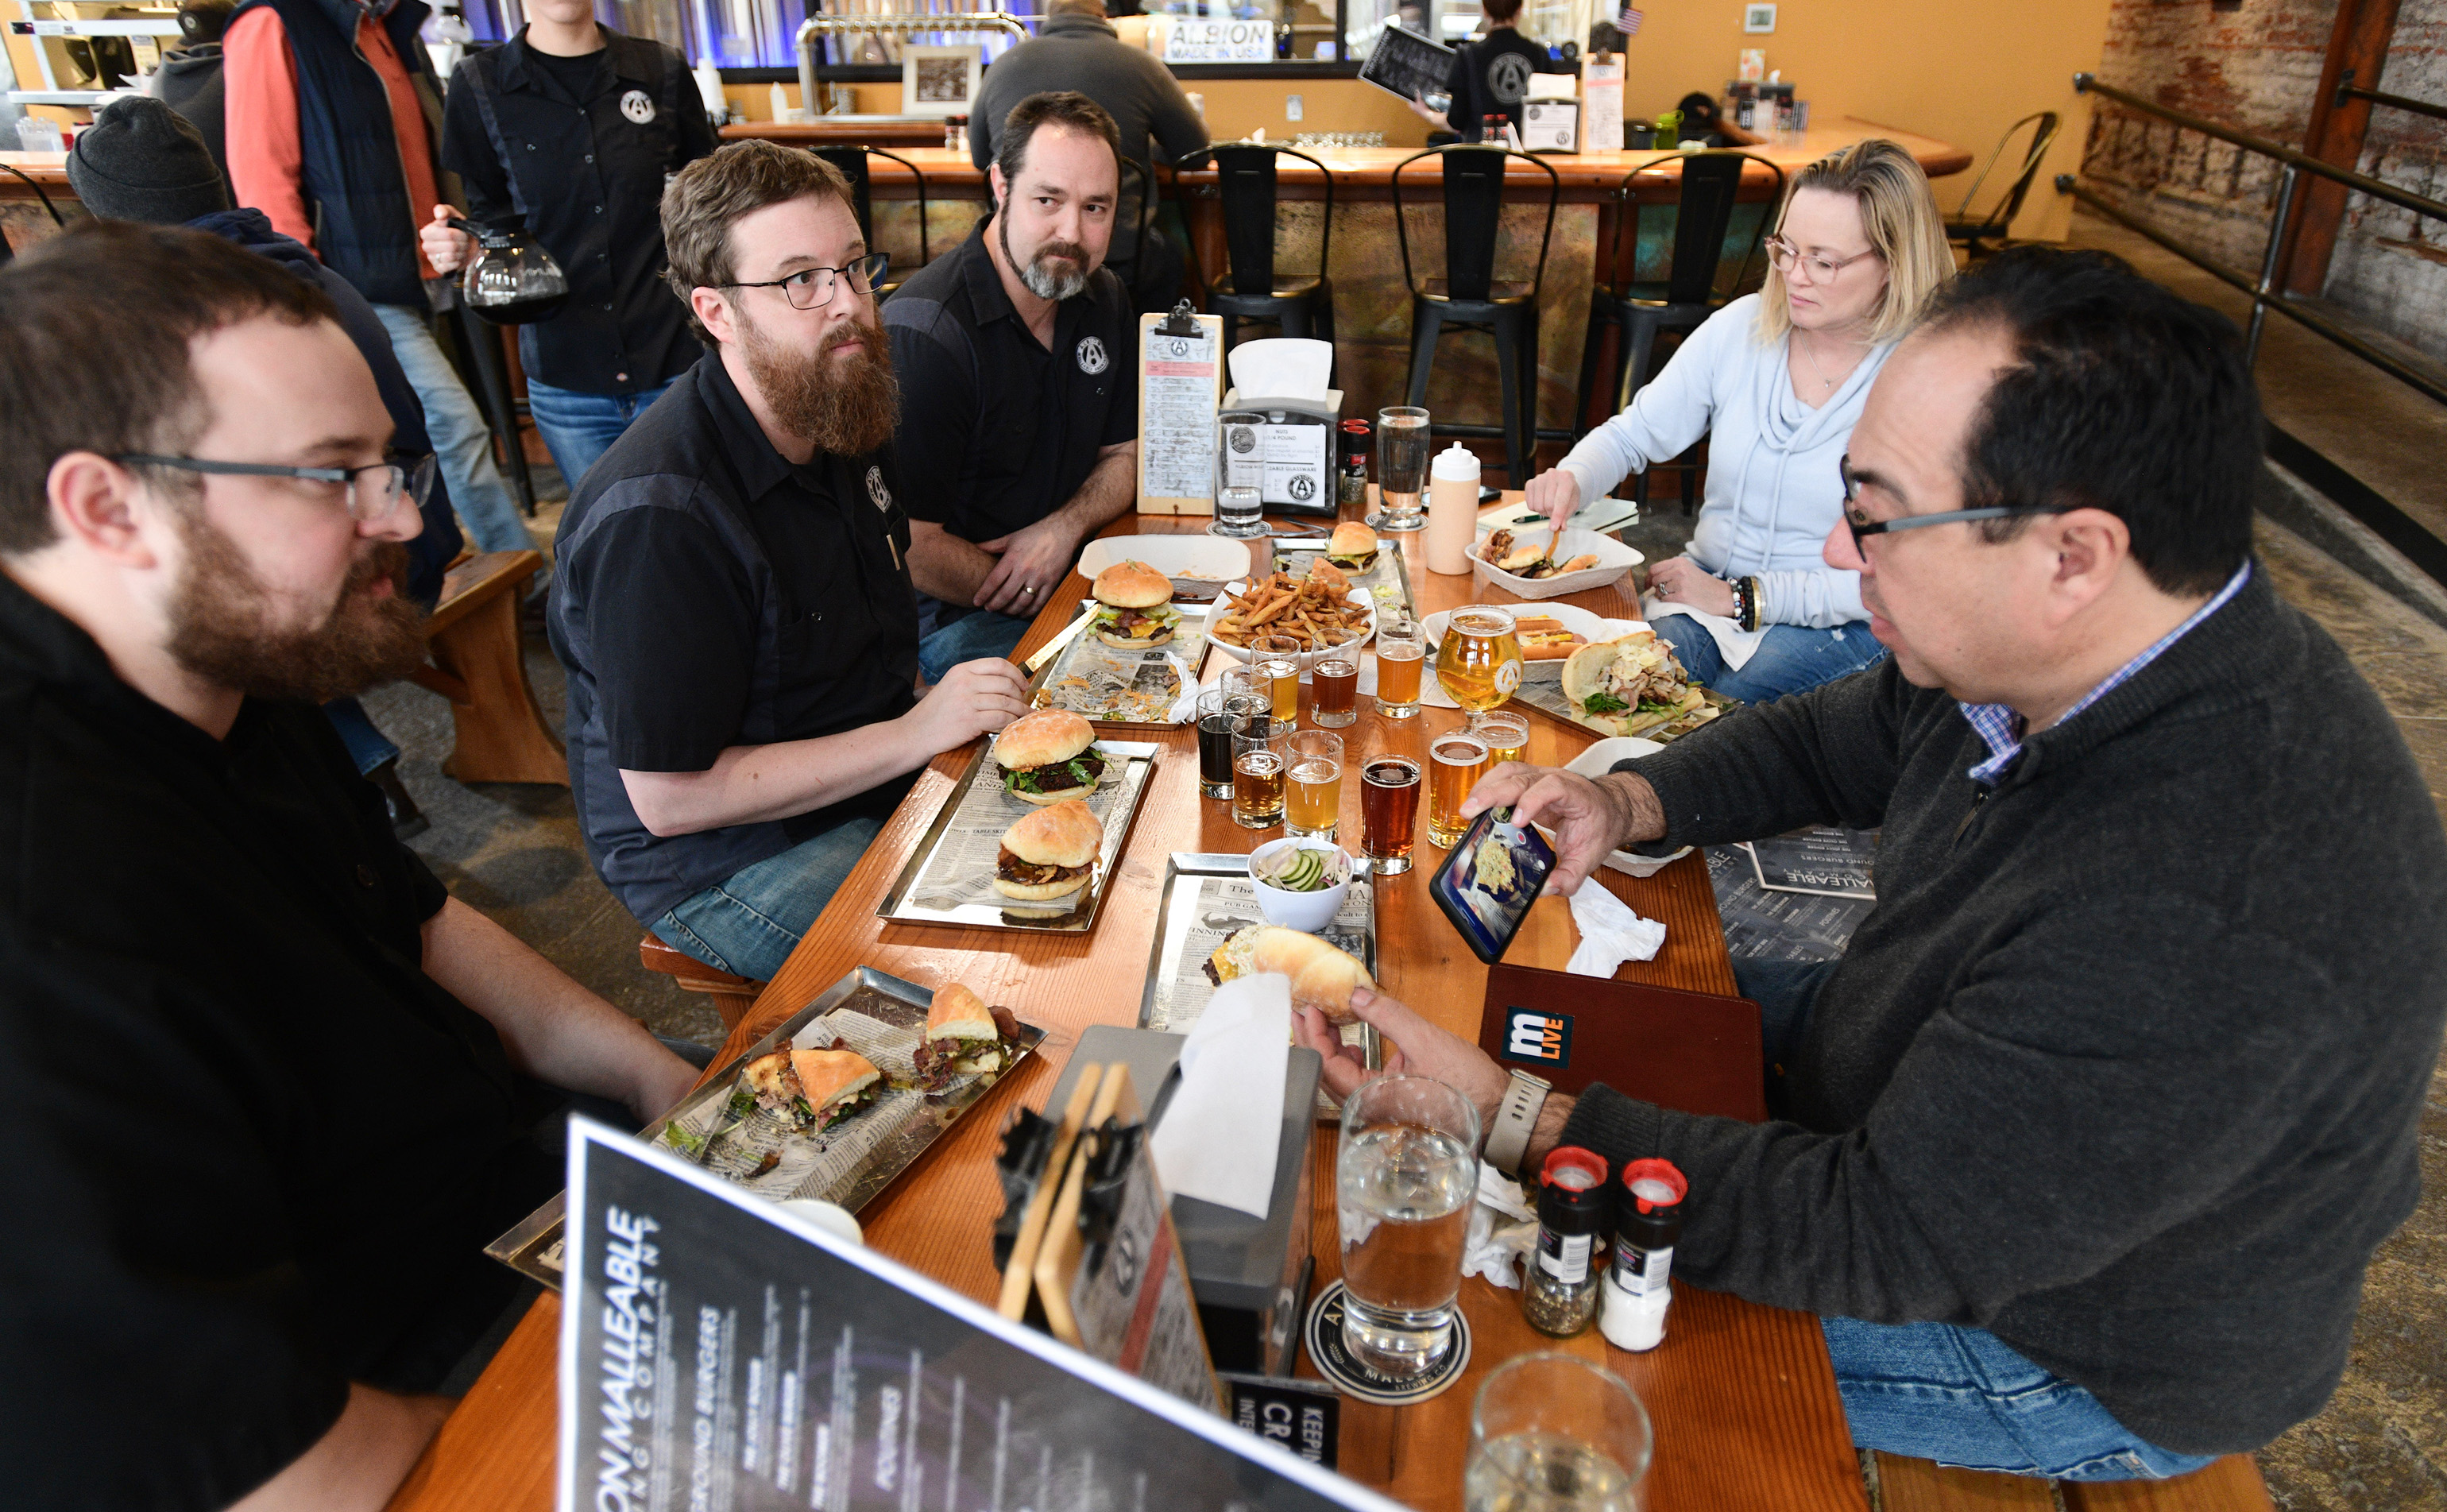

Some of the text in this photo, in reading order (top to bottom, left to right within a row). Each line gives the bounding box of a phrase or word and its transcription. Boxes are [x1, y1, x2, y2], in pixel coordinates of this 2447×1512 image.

[1170, 25, 1267, 44] ALBION
[1172, 46, 1266, 58] MADE IN USA
[1800, 854, 1844, 864] BURGERS
[1229, 884, 1254, 894] The
[1540, 1018, 1564, 1061] LIVE
[599, 1204, 643, 1452] MALLEABLE
[633, 1216, 662, 1421] COMPANY
[695, 1305, 721, 1415] BURGERS
[1395, 1374, 1432, 1391] BREWING
